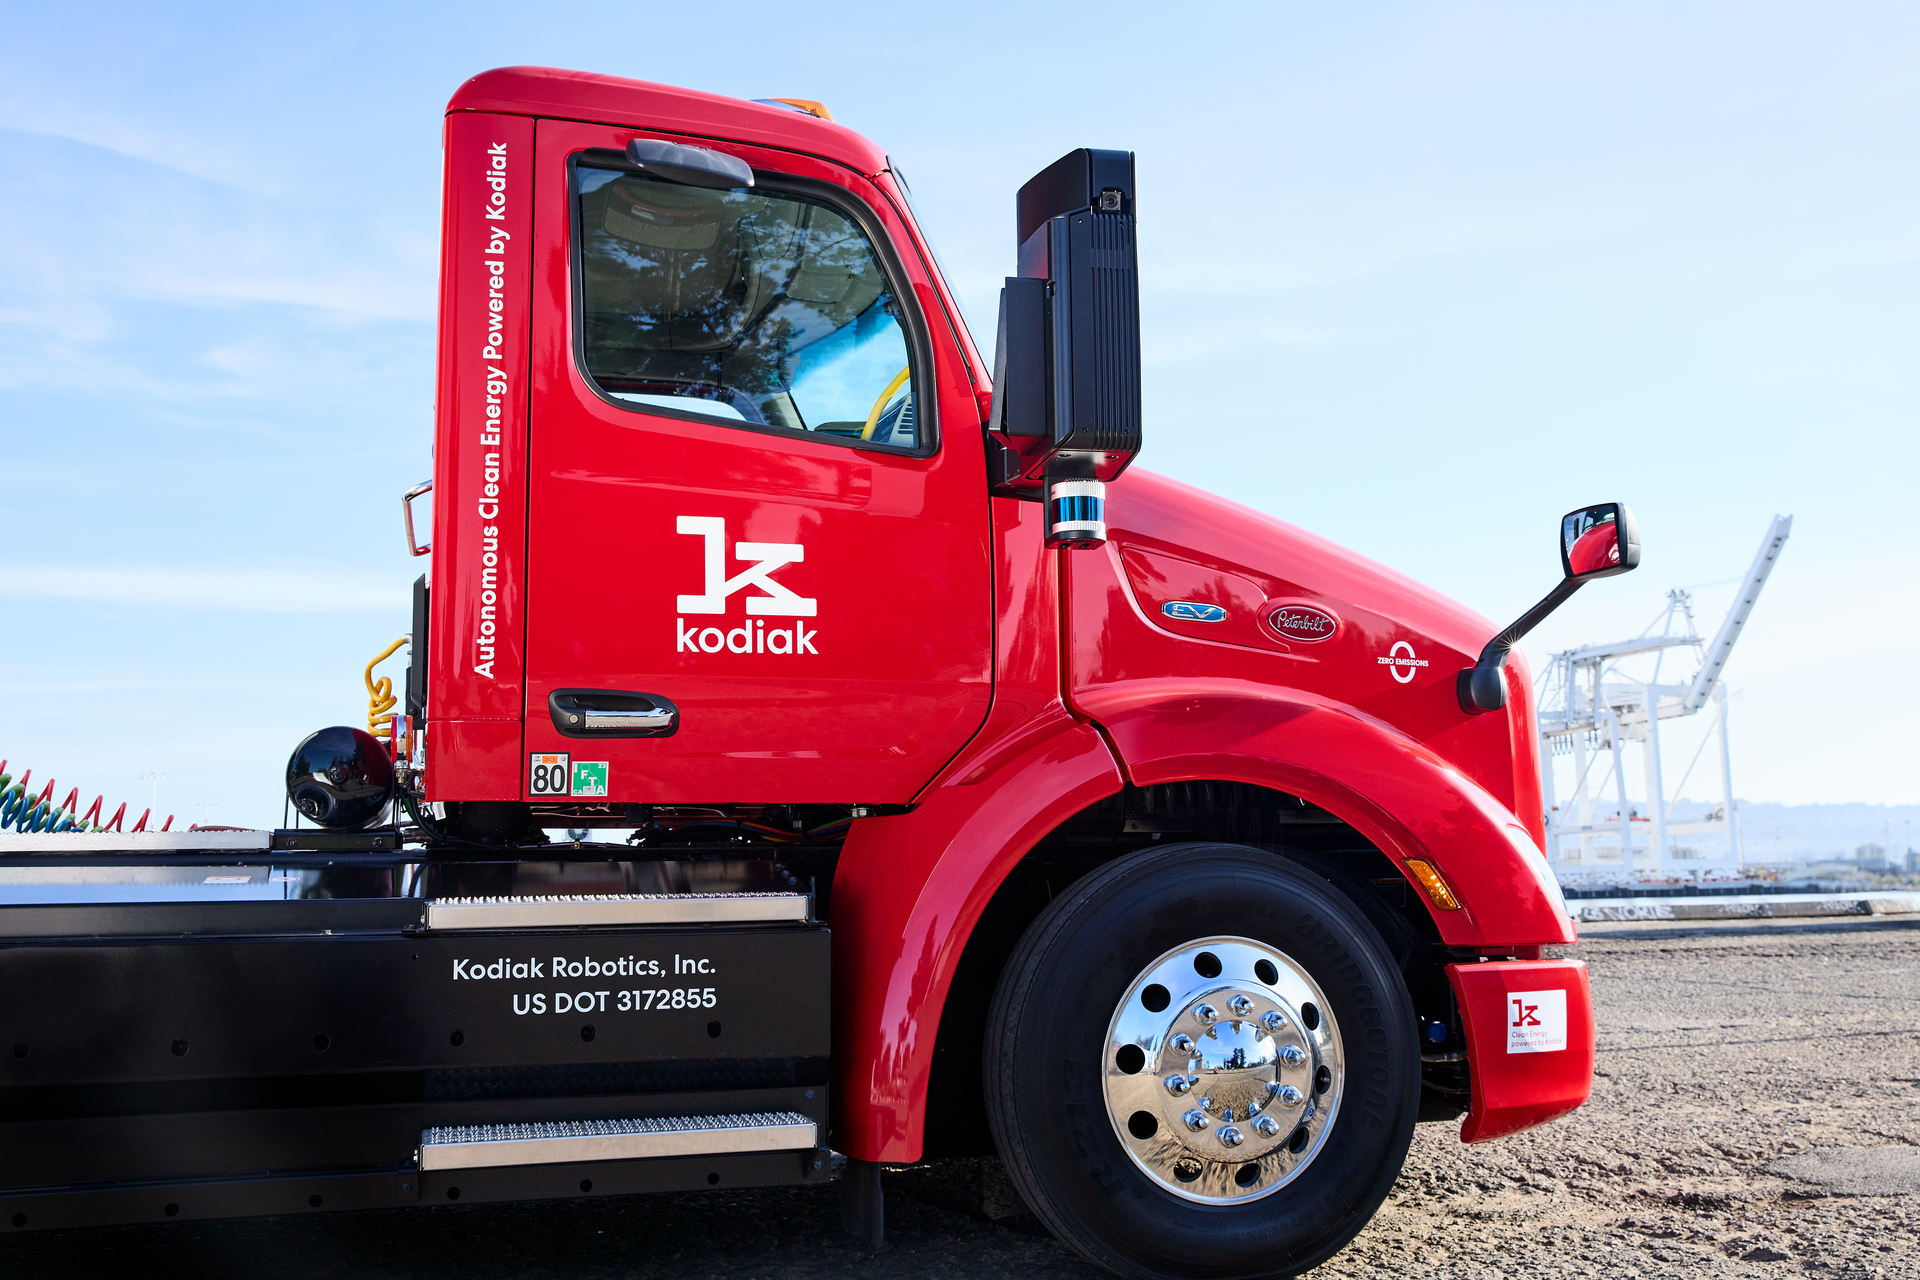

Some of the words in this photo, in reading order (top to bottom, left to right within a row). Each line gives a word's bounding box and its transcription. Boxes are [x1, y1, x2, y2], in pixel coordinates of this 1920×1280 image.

[486, 141, 507, 221] Kodiak
[485, 225, 511, 255] by
[482, 260, 505, 360] Powered
[481, 365, 508, 447] Energy
[479, 452, 500, 521] Clean
[473, 526, 499, 680] Autonomous
[1171, 603, 1217, 619] EV
[1276, 610, 1330, 632] Peterbilt
[676, 617, 819, 655] kodiak
[1377, 656, 1394, 665] ZERO
[1395, 658, 1429, 668] EMISSIONS
[532, 764, 566, 793] 80
[453, 957, 545, 980] Kodiak
[552, 955, 666, 978] Robotics,
[674, 954, 716, 975] Inc.
[513, 993, 547, 1016] US
[555, 990, 610, 1014] DOT
[617, 987, 717, 1011] 3172855
[1511, 1031, 1529, 1039] Clean
[1529, 1030, 1548, 1039] Energy
[1511, 1040, 1537, 1048] powered
[1537, 1039, 1545, 1047] by
